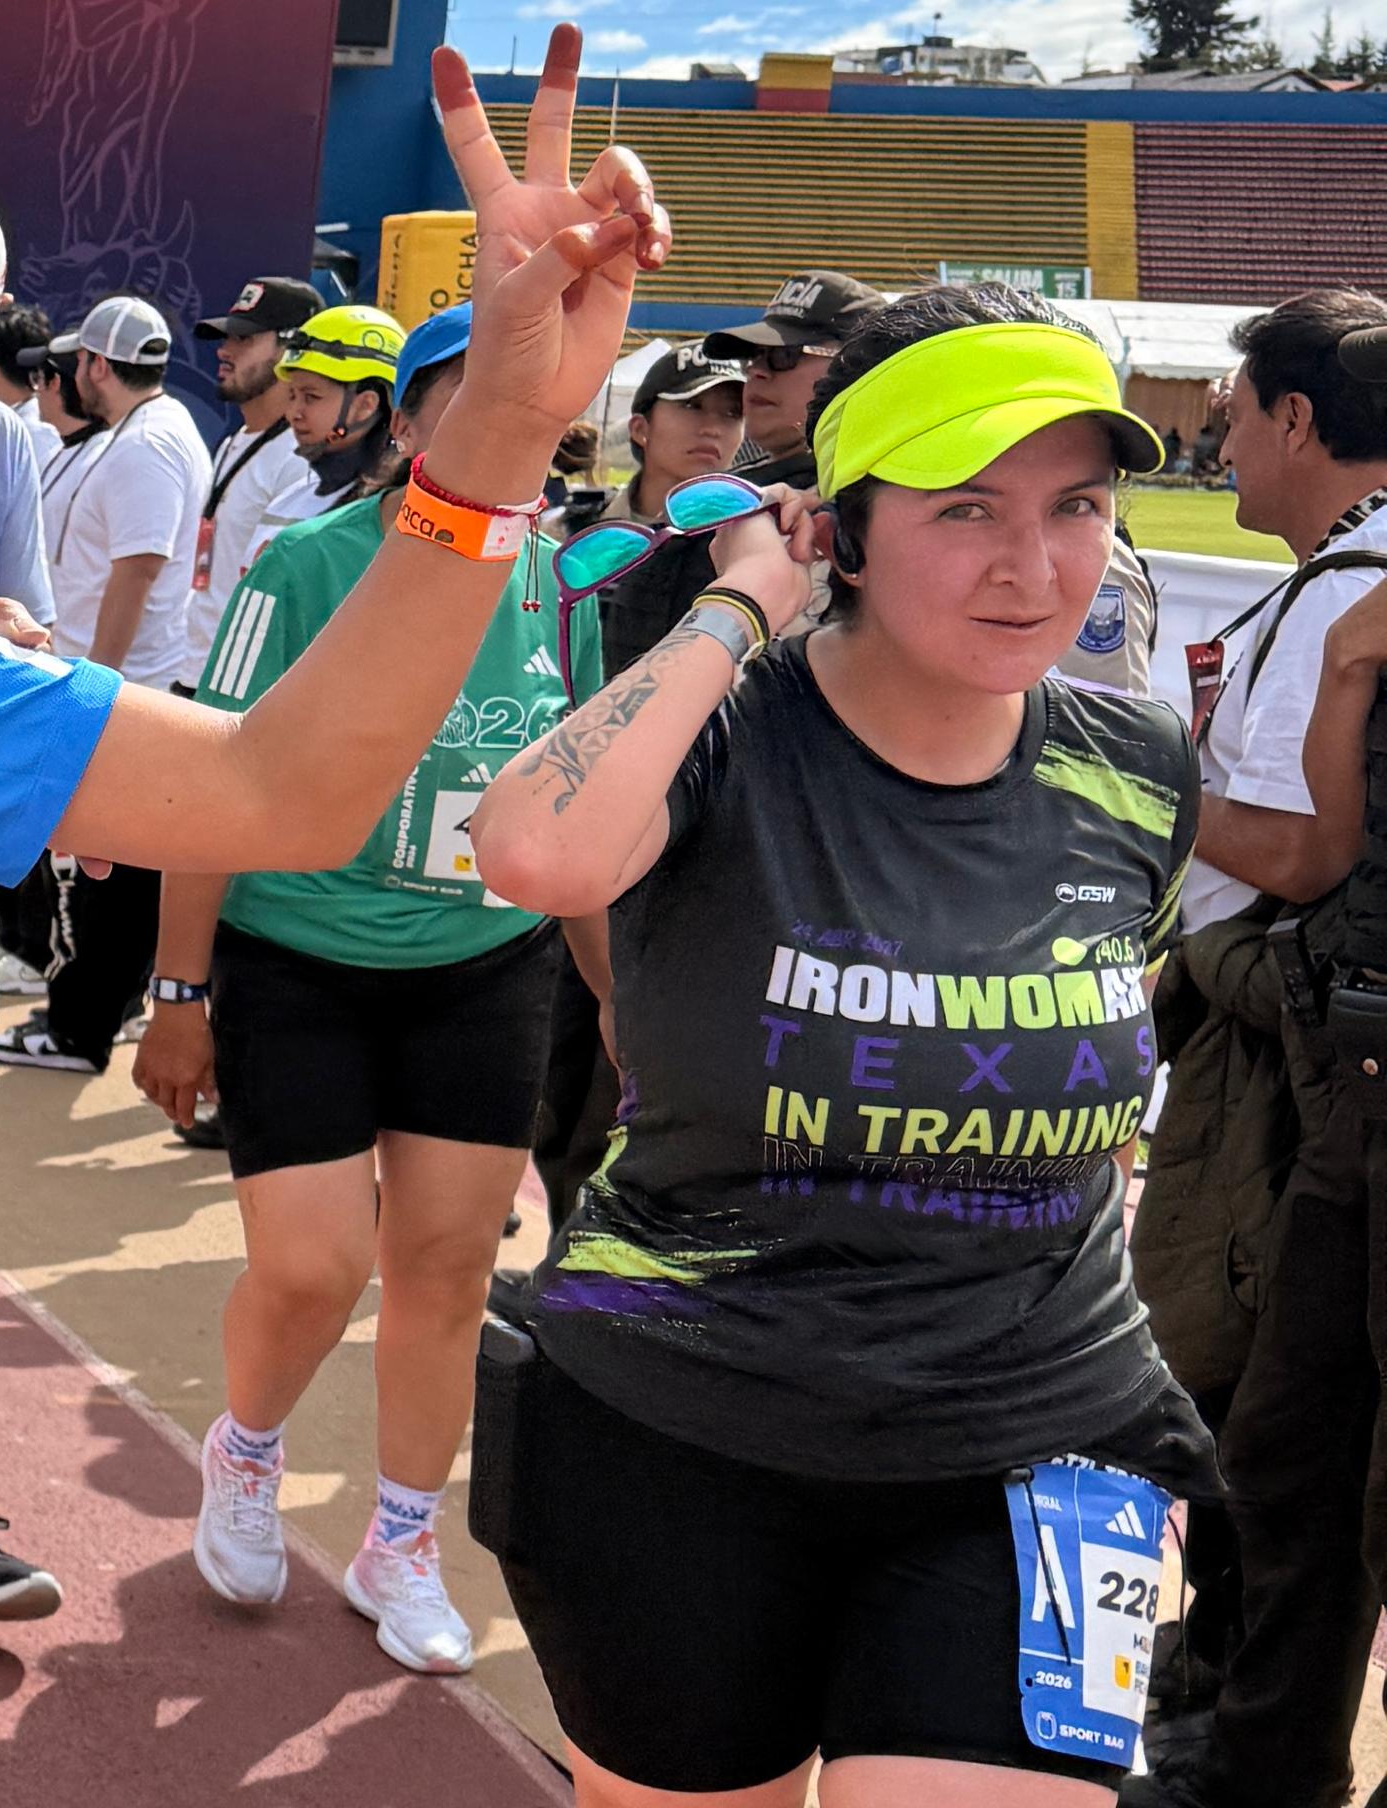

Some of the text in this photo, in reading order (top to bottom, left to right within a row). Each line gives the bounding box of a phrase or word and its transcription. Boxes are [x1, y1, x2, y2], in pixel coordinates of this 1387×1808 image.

[1077, 885, 1116, 903] GSW
[764, 945, 1149, 1030] IRONWOMAN
[758, 1013, 1154, 1094] TEXAS
[764, 1085, 1143, 1158] IN TRAINING
[1031, 1524, 1076, 1629] A
[1035, 1670, 1073, 1690] 2026
[1059, 1724, 1125, 1751] SPORT BAG
